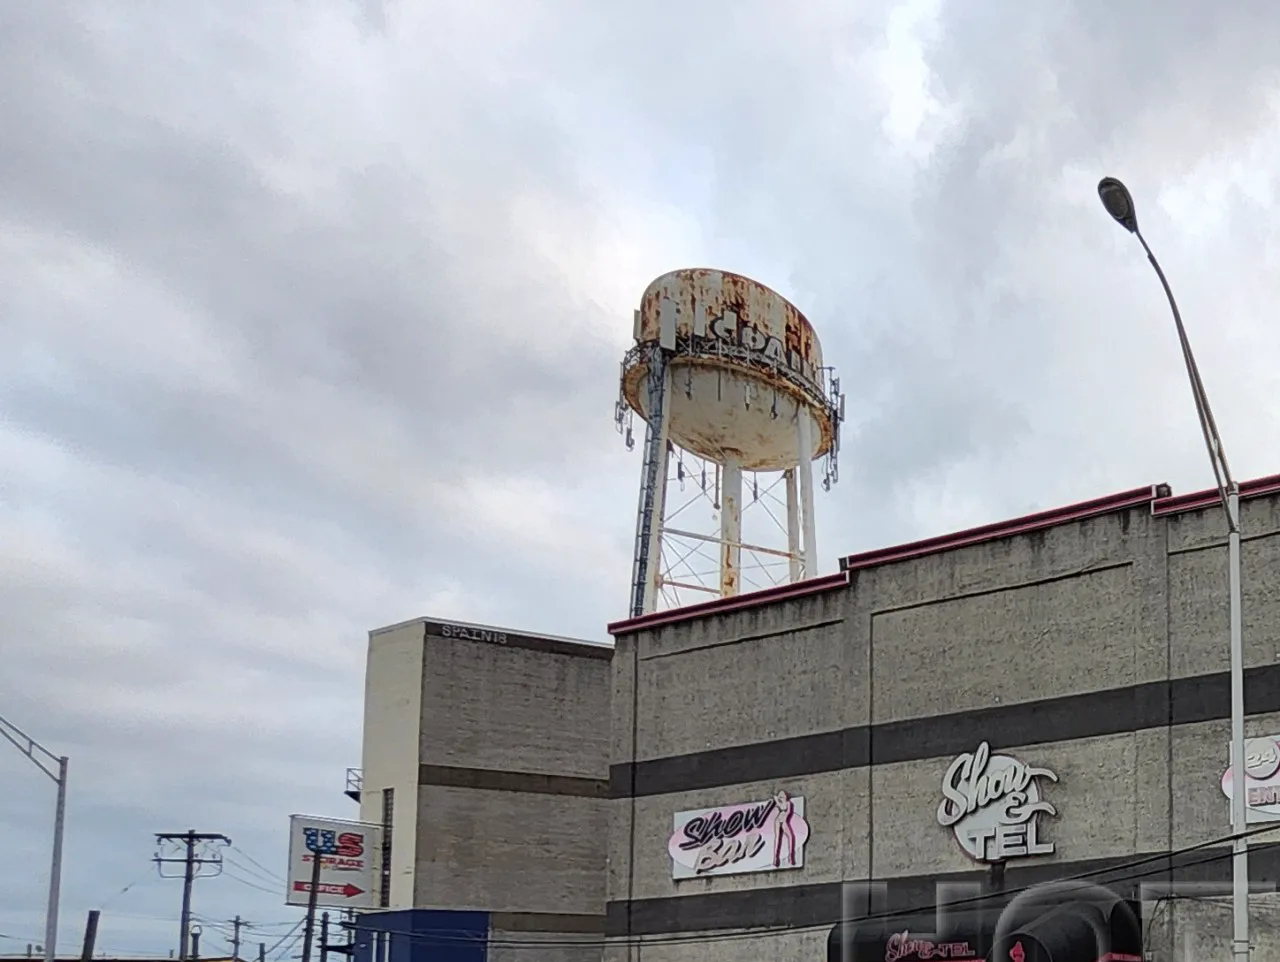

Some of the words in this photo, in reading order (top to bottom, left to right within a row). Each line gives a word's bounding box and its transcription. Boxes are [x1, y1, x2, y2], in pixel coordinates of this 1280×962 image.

[937, 741, 1059, 826] Show
[303, 827, 364, 857] US
[967, 818, 1056, 861] TEL
